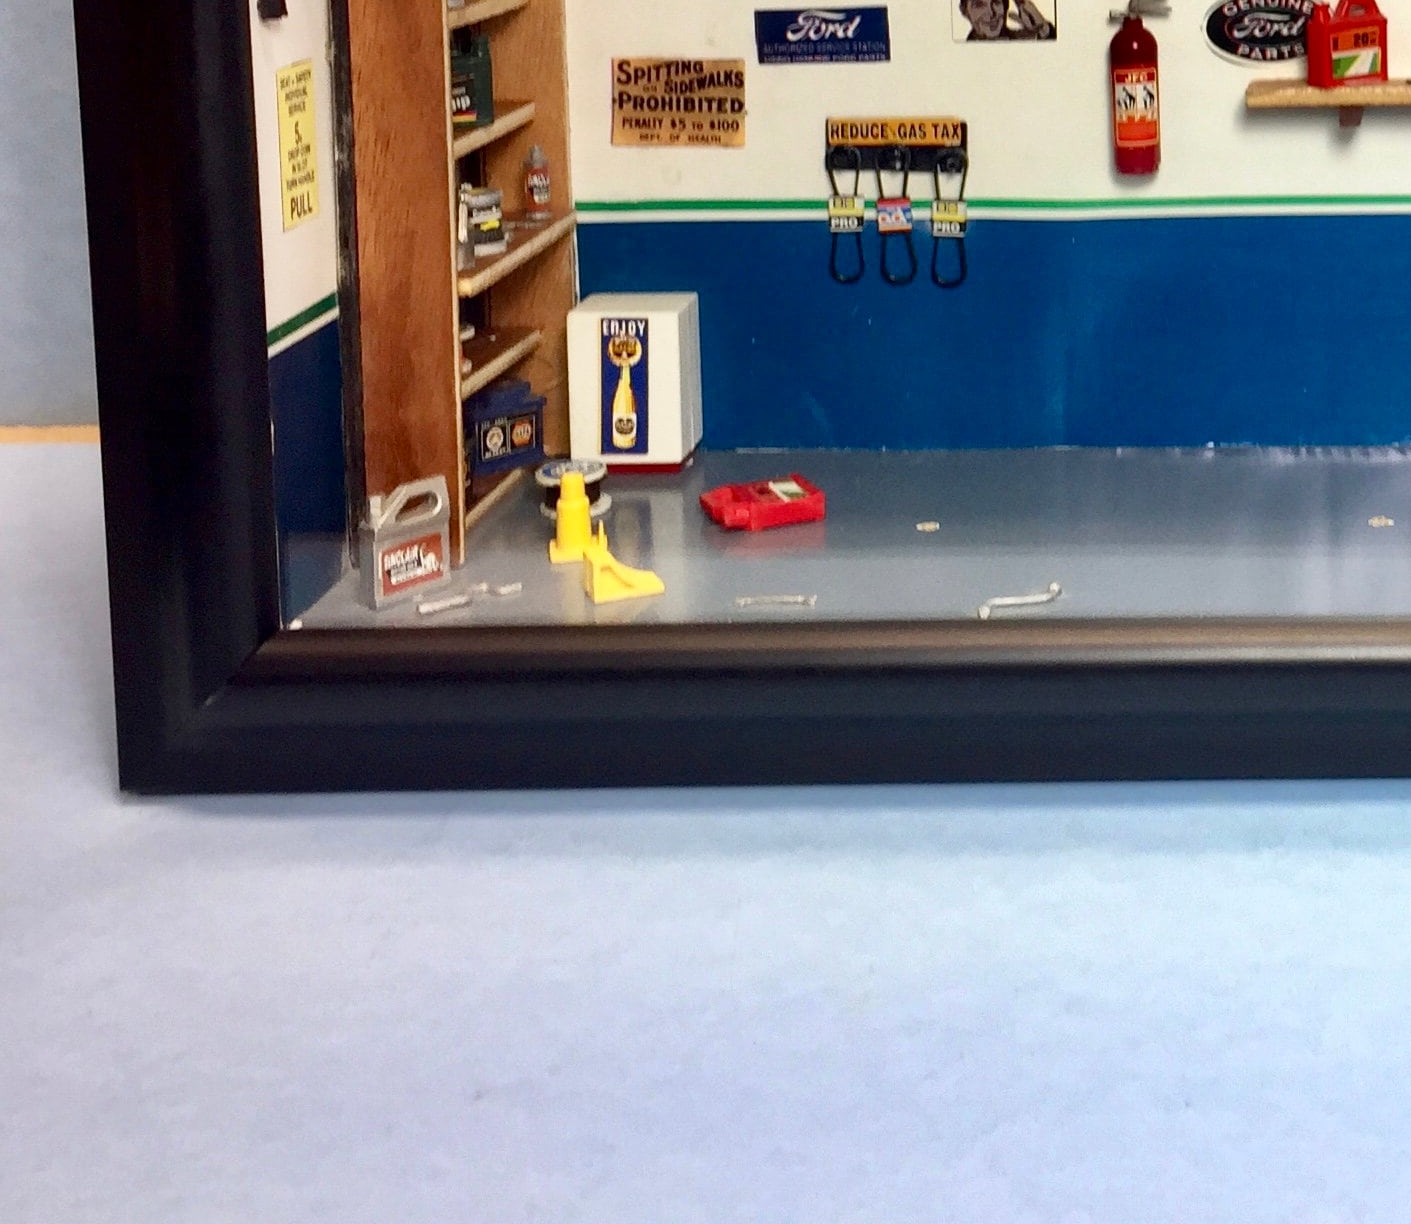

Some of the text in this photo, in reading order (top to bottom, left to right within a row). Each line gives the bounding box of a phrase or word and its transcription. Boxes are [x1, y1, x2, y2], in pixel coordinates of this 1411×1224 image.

[786, 9, 861, 42] Ford
[1233, 11, 1306, 39] Ford
[1237, 43, 1306, 60] PARTS
[616, 60, 703, 85] SPITTING
[664, 69, 744, 94] SIDEWALKS
[617, 91, 744, 114] PROHIBITED
[622, 117, 663, 130] PENALTY
[830, 123, 960, 139] REDUCE GAS TAX
[688, 134, 721, 143] HEALTH
[290, 192, 313, 220] PULL
[830, 217, 858, 229] PRO
[933, 222, 960, 233] PRO
